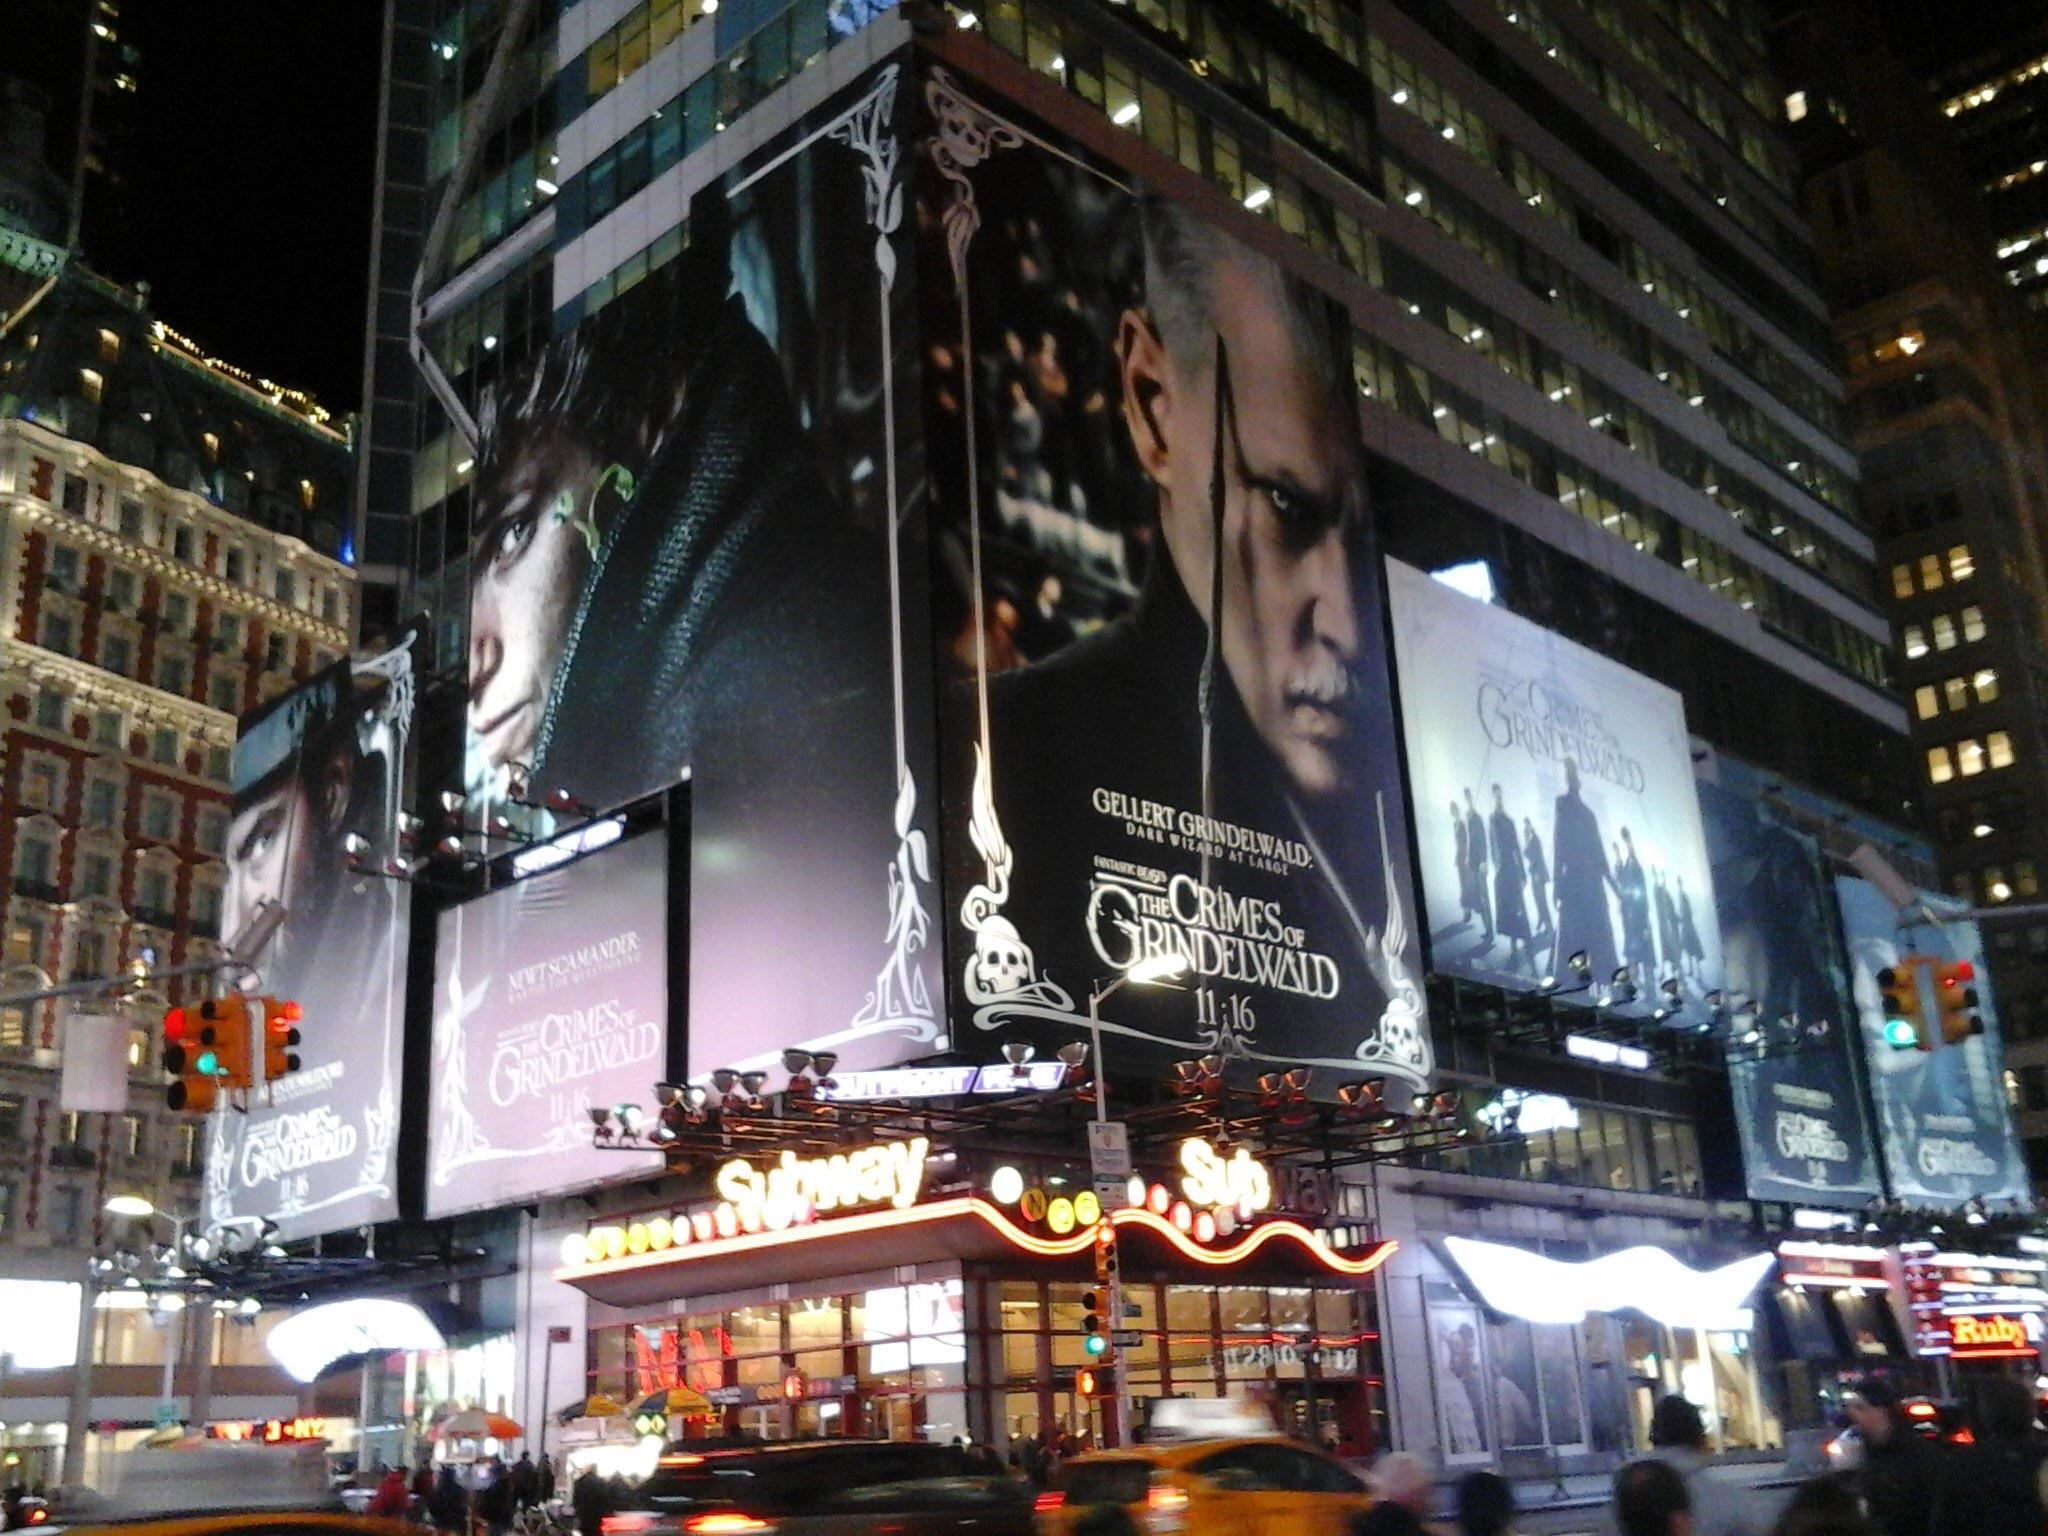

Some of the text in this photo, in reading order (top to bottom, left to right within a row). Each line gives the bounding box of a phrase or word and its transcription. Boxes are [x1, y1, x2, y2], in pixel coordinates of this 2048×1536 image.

[1092, 788, 1310, 868] GELLERT GRINDELWALD
[1126, 823, 1288, 876] DARK WIZARD AT LARGE
[1086, 884, 1340, 1000] GRINDELWALD
[1137, 873, 1305, 948] THE CRIMES OF
[540, 999, 620, 1052] CRIMES
[488, 1021, 660, 1107] GRINDELWALD
[716, 1137, 930, 1210] Subway
[1951, 1313, 2025, 1348] Ruby
